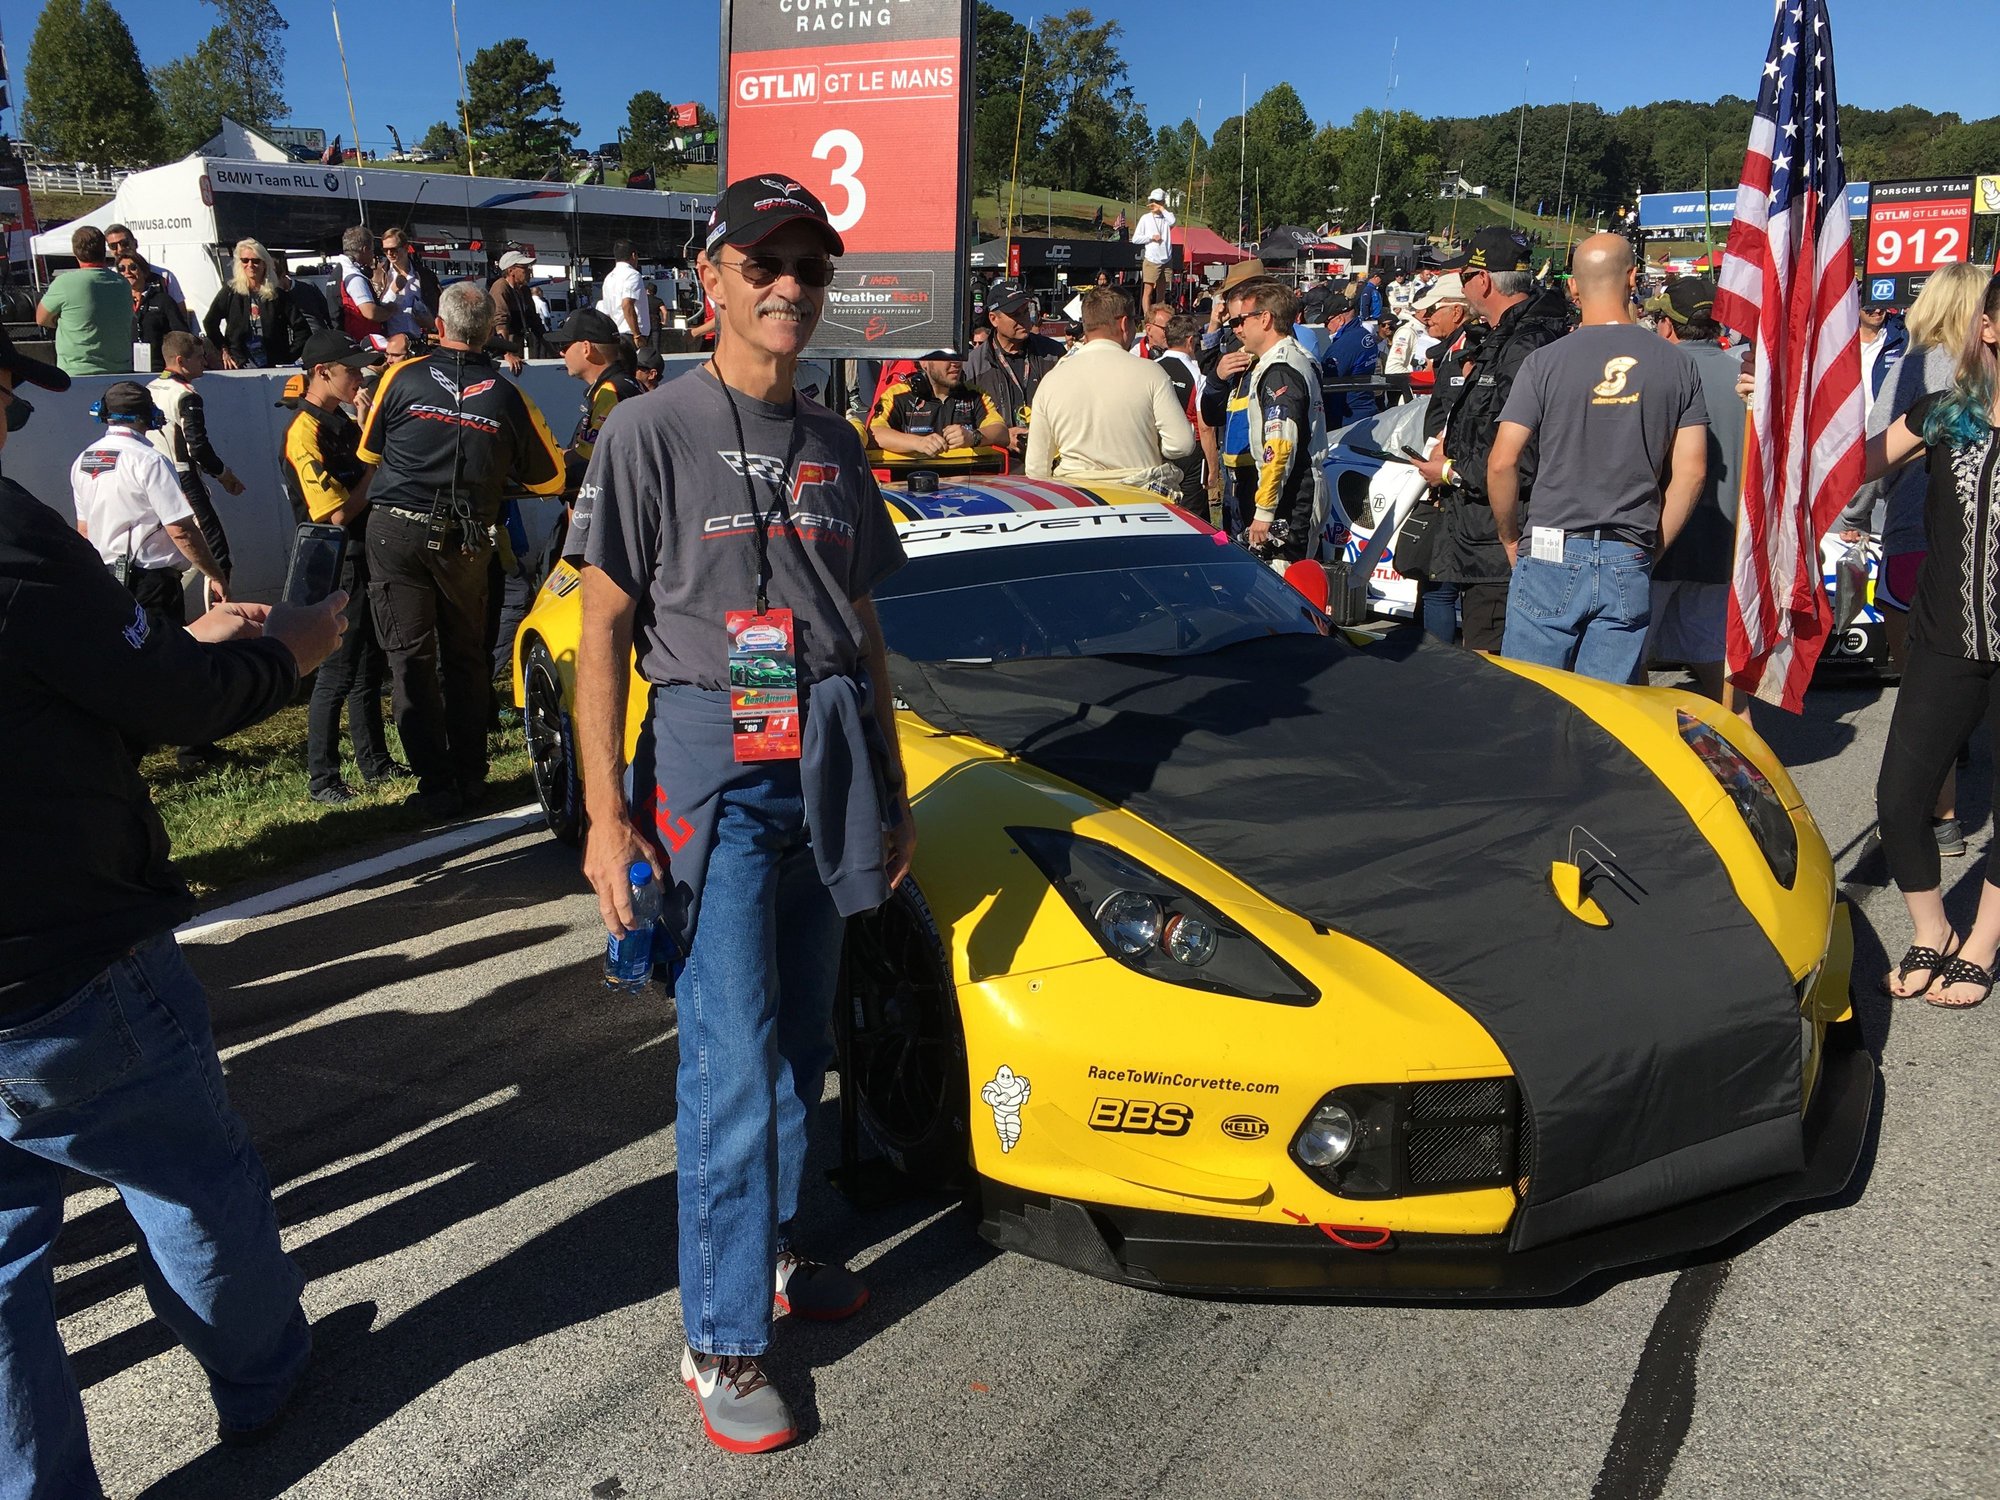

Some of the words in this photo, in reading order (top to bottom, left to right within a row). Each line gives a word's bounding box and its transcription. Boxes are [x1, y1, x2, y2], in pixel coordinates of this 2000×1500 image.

[796, 9, 892, 33] RACING
[739, 73, 816, 101] GTLM
[824, 74, 853, 94] GT
[858, 71, 884, 92] LE
[891, 67, 953, 89] MANS
[217, 171, 252, 184] BMW
[256, 173, 291, 187] Team
[294, 175, 319, 189] RLL
[811, 129, 867, 232] 3
[1875, 186, 1921, 196] PORSCHE
[1925, 185, 1938, 193] GT
[1943, 183, 1970, 192] TEAM
[1672, 205, 1694, 214] THE
[1875, 210, 1910, 221] GTLM
[1928, 209, 1939, 217] LE
[1941, 207, 1968, 217] MANS
[1876, 227, 1960, 267] 912
[828, 290, 929, 303] WeatherTech
[1876, 284, 1890, 295] ZF
[407, 410, 498, 433] RACING
[408, 404, 501, 428] CORVETTE
[704, 511, 855, 537] CORVETTE
[1088, 1065, 1280, 1095] RaceToWinCorvette.com
[1088, 1096, 1195, 1137] BBS
[1224, 1121, 1270, 1136] HELLA
